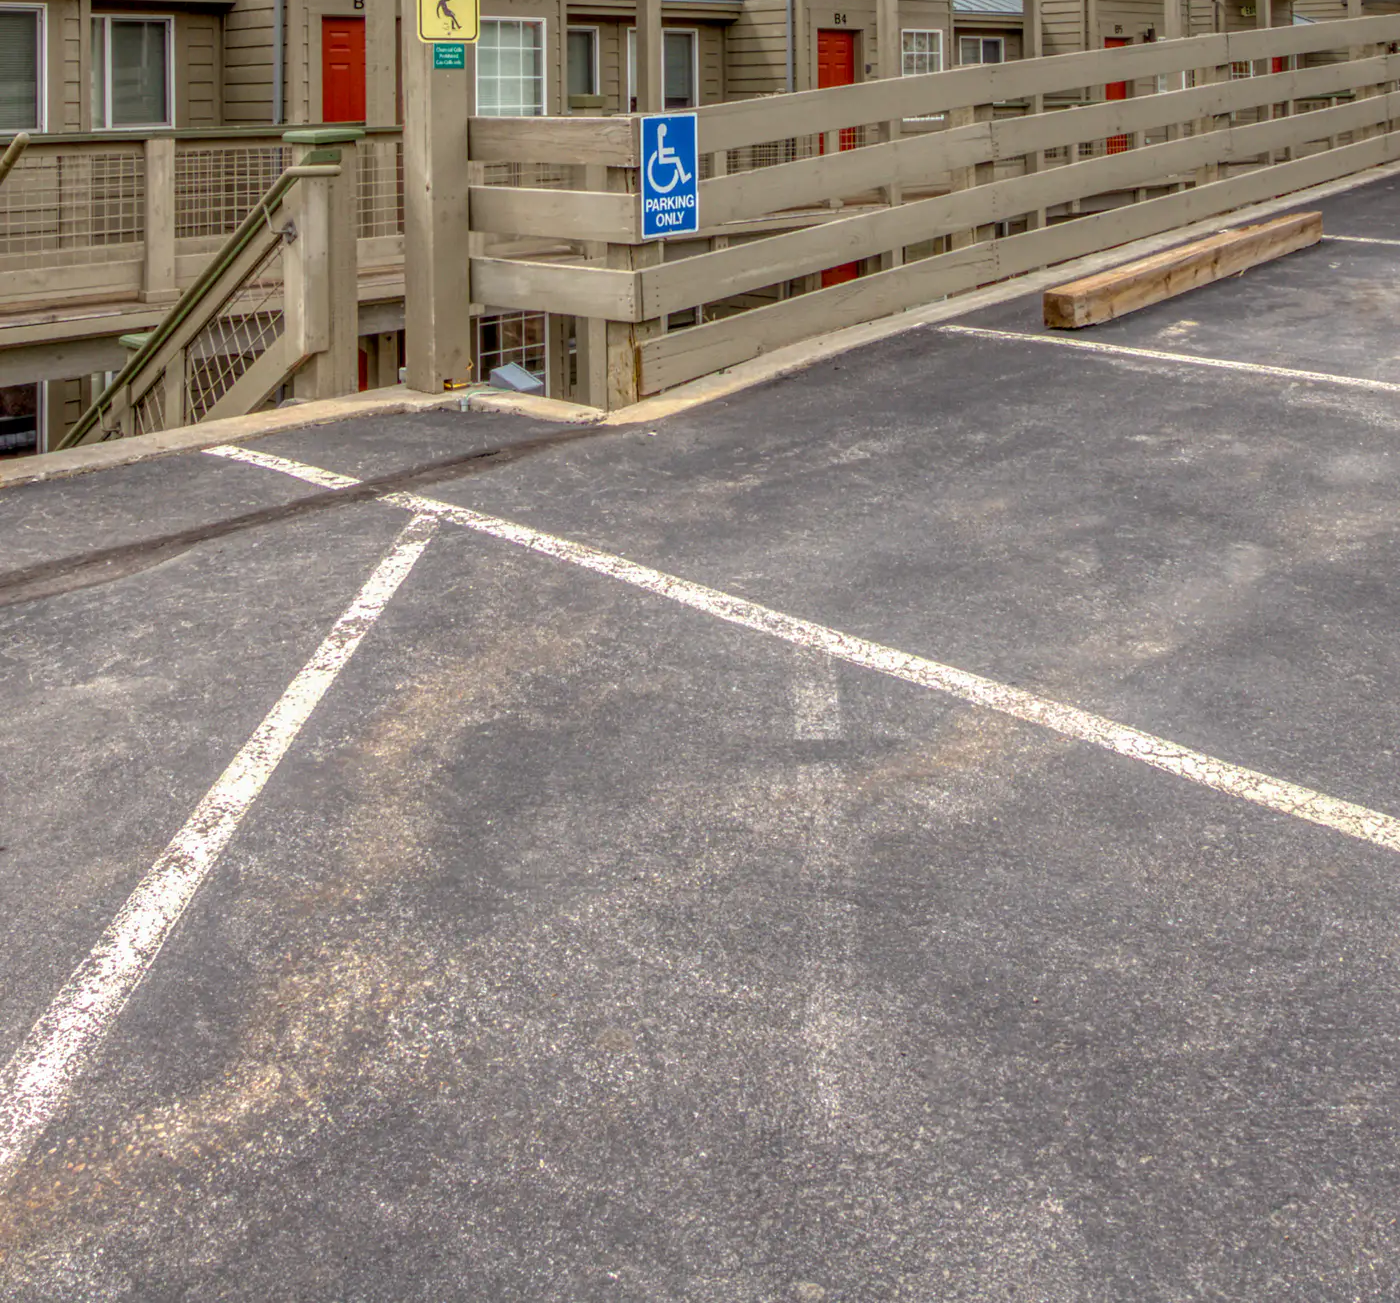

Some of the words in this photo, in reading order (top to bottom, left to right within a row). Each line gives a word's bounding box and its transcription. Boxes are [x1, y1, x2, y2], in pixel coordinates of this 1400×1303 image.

[834, 13, 846, 24] B4
[646, 194, 695, 212] PARKING
[656, 211, 685, 227] ONLY
